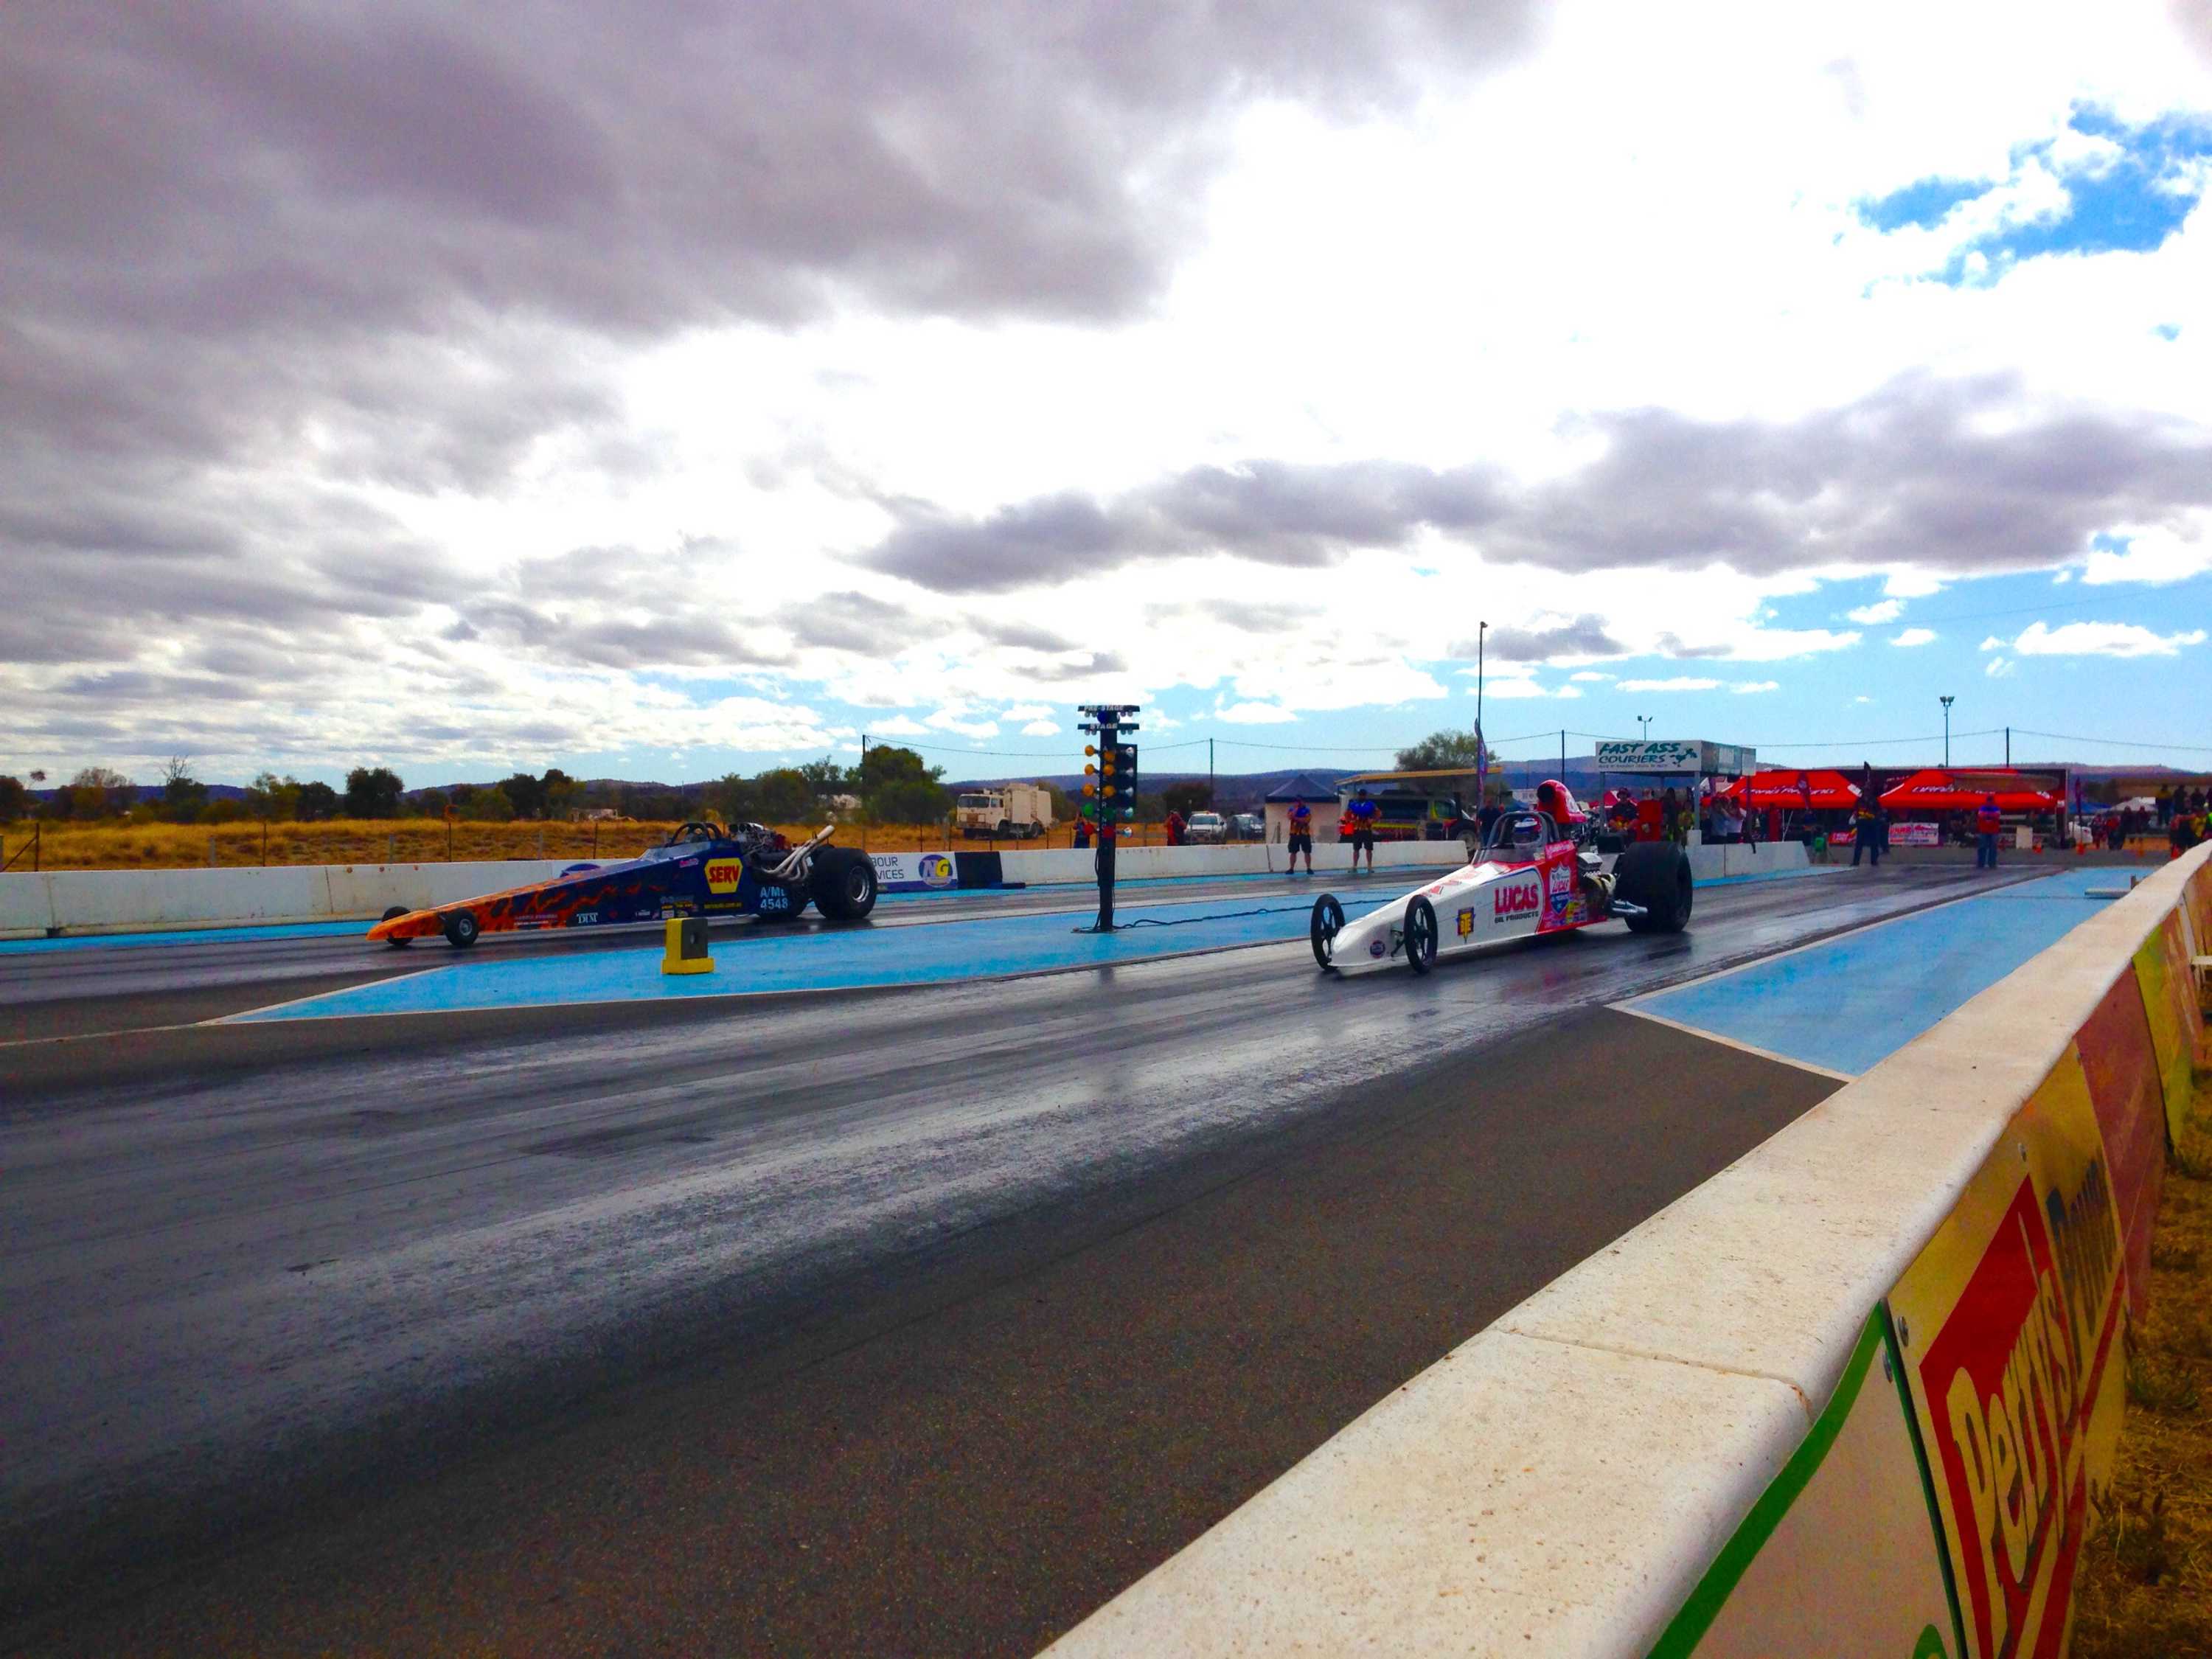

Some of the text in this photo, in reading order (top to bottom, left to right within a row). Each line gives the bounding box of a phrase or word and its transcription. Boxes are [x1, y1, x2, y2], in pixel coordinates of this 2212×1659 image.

[1599, 742, 1681, 755] FAST ASS
[1598, 754, 1666, 764] COURIERS
[708, 866, 740, 884] SERV
[760, 897, 788, 909] 4548
[1494, 884, 1539, 914] LUCAS
[1506, 911, 1539, 921] PRODUCTS
